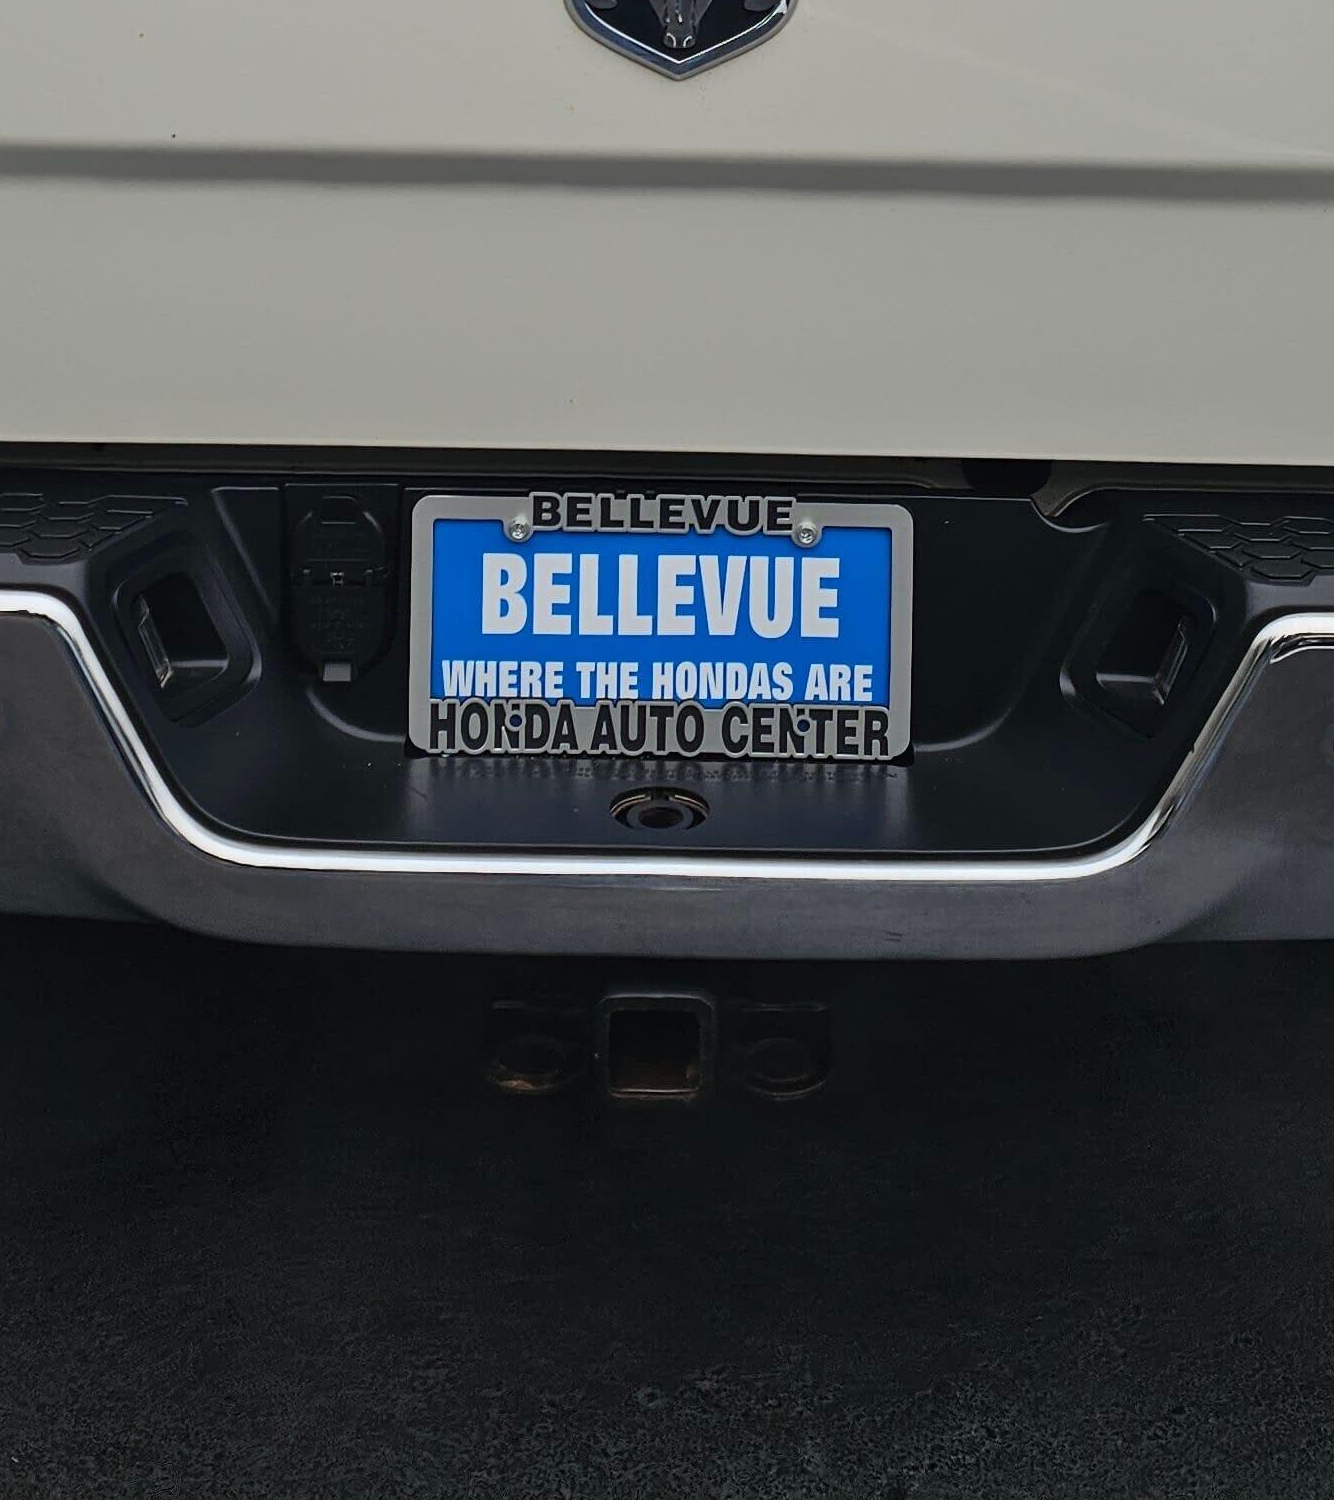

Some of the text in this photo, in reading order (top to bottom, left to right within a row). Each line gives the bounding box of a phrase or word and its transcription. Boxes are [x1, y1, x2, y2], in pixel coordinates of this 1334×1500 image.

[532, 494, 795, 532] BELLEVUE
[481, 552, 840, 638] BELLEVUE
[441, 659, 873, 701] WHERE THE HONDAS ARE
[429, 699, 888, 757] HONDA AUTO CENTER
